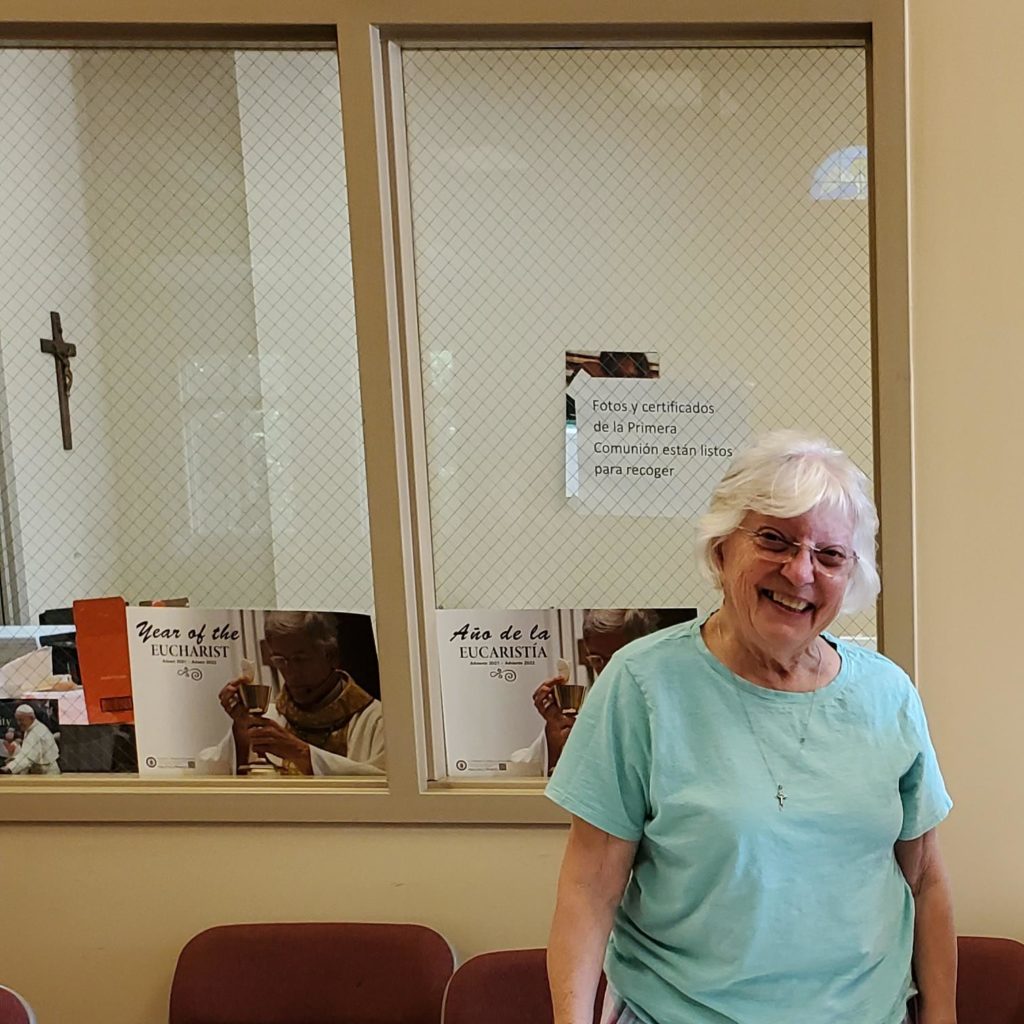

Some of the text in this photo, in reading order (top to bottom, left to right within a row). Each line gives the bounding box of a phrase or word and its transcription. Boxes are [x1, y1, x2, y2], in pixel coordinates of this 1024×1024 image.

[592, 399, 715, 415] Fotos y certificados
[593, 420, 677, 434] de la Primera
[593, 441, 733, 457] Comunión están listos
[594, 464, 675, 479] para recoger
[136, 620, 240, 645] Year of the
[449, 623, 551, 642] Año de la
[151, 643, 230, 658] EUCHARIST
[459, 642, 548, 659] EUCARISTÍA
